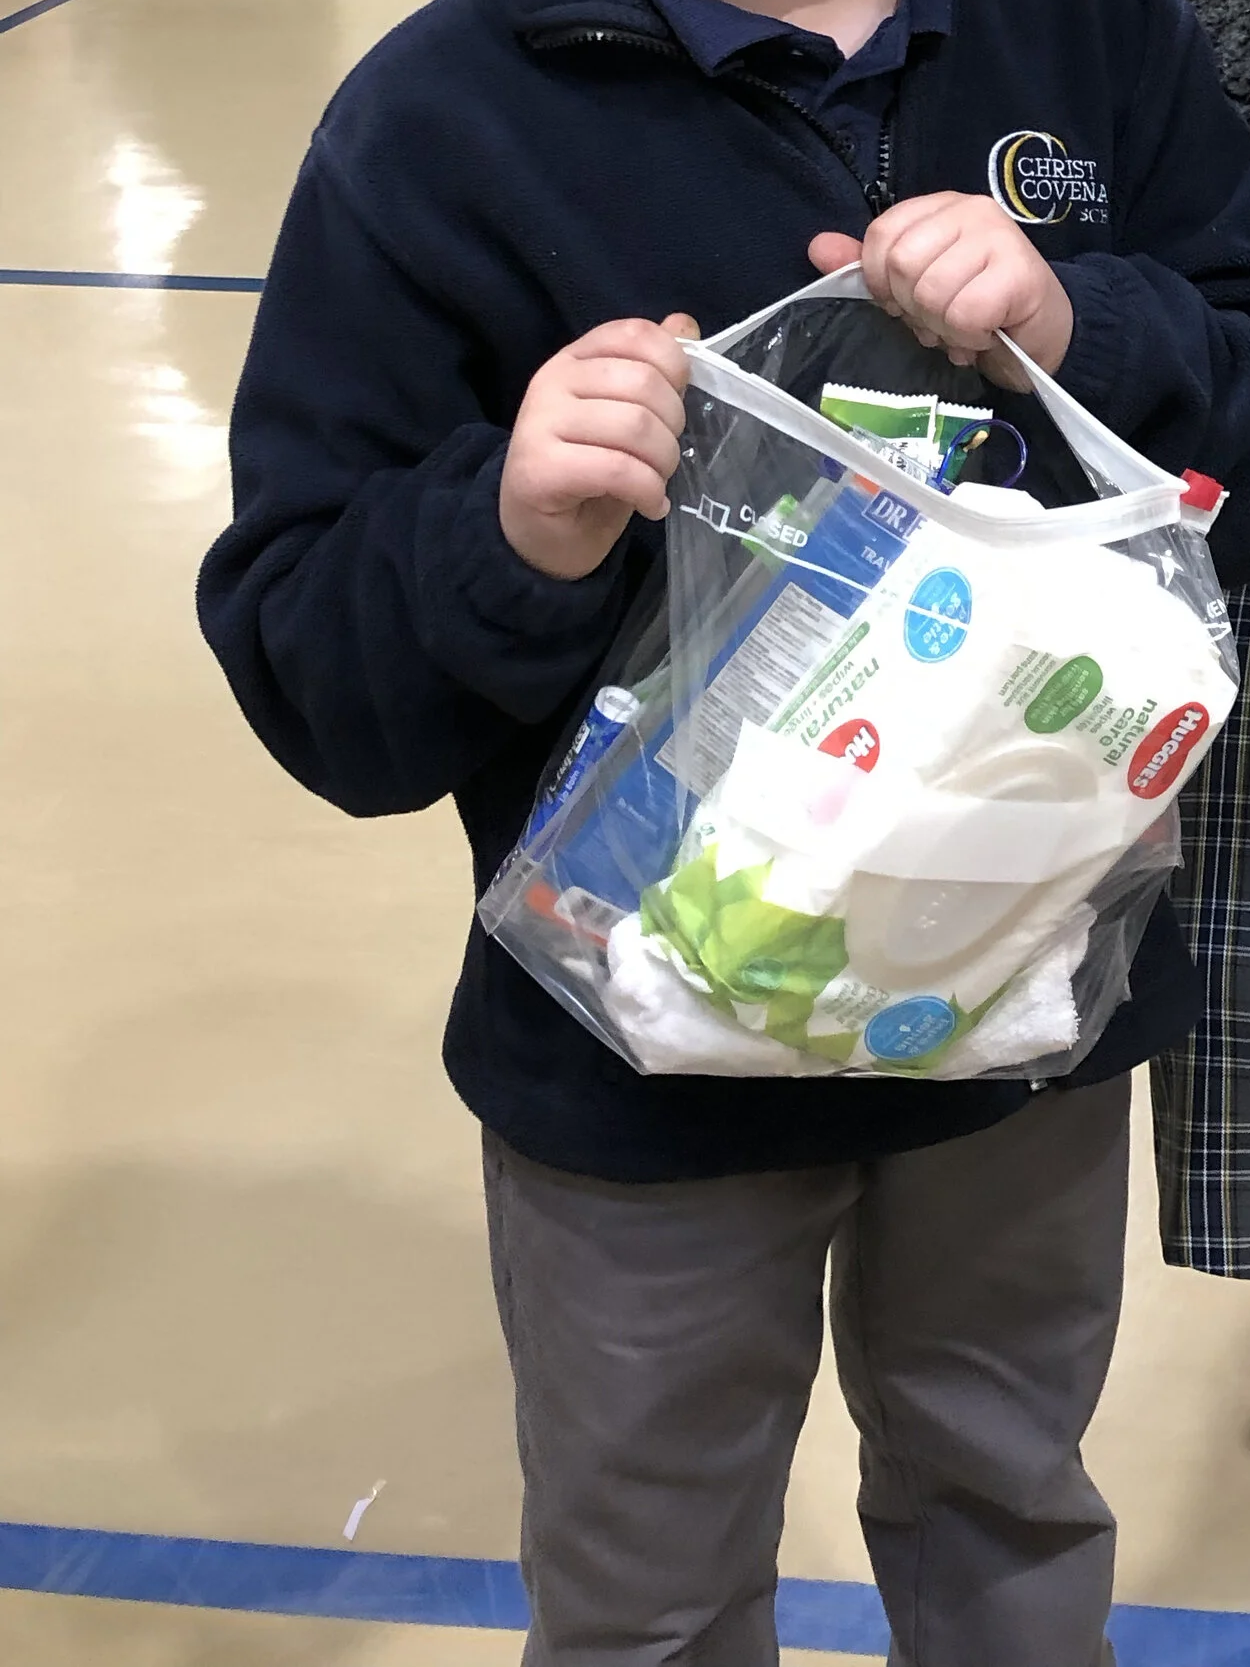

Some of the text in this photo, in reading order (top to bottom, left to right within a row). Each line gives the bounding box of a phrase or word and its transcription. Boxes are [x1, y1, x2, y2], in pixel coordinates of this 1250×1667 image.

[1018, 157, 1097, 179] CHRIST
[873, 496, 905, 532] DR.
[801, 657, 880, 747] natural
[1098, 706, 1136, 748] care
[1104, 698, 1158, 767] natural
[1132, 706, 1204, 789] HUGGIES
